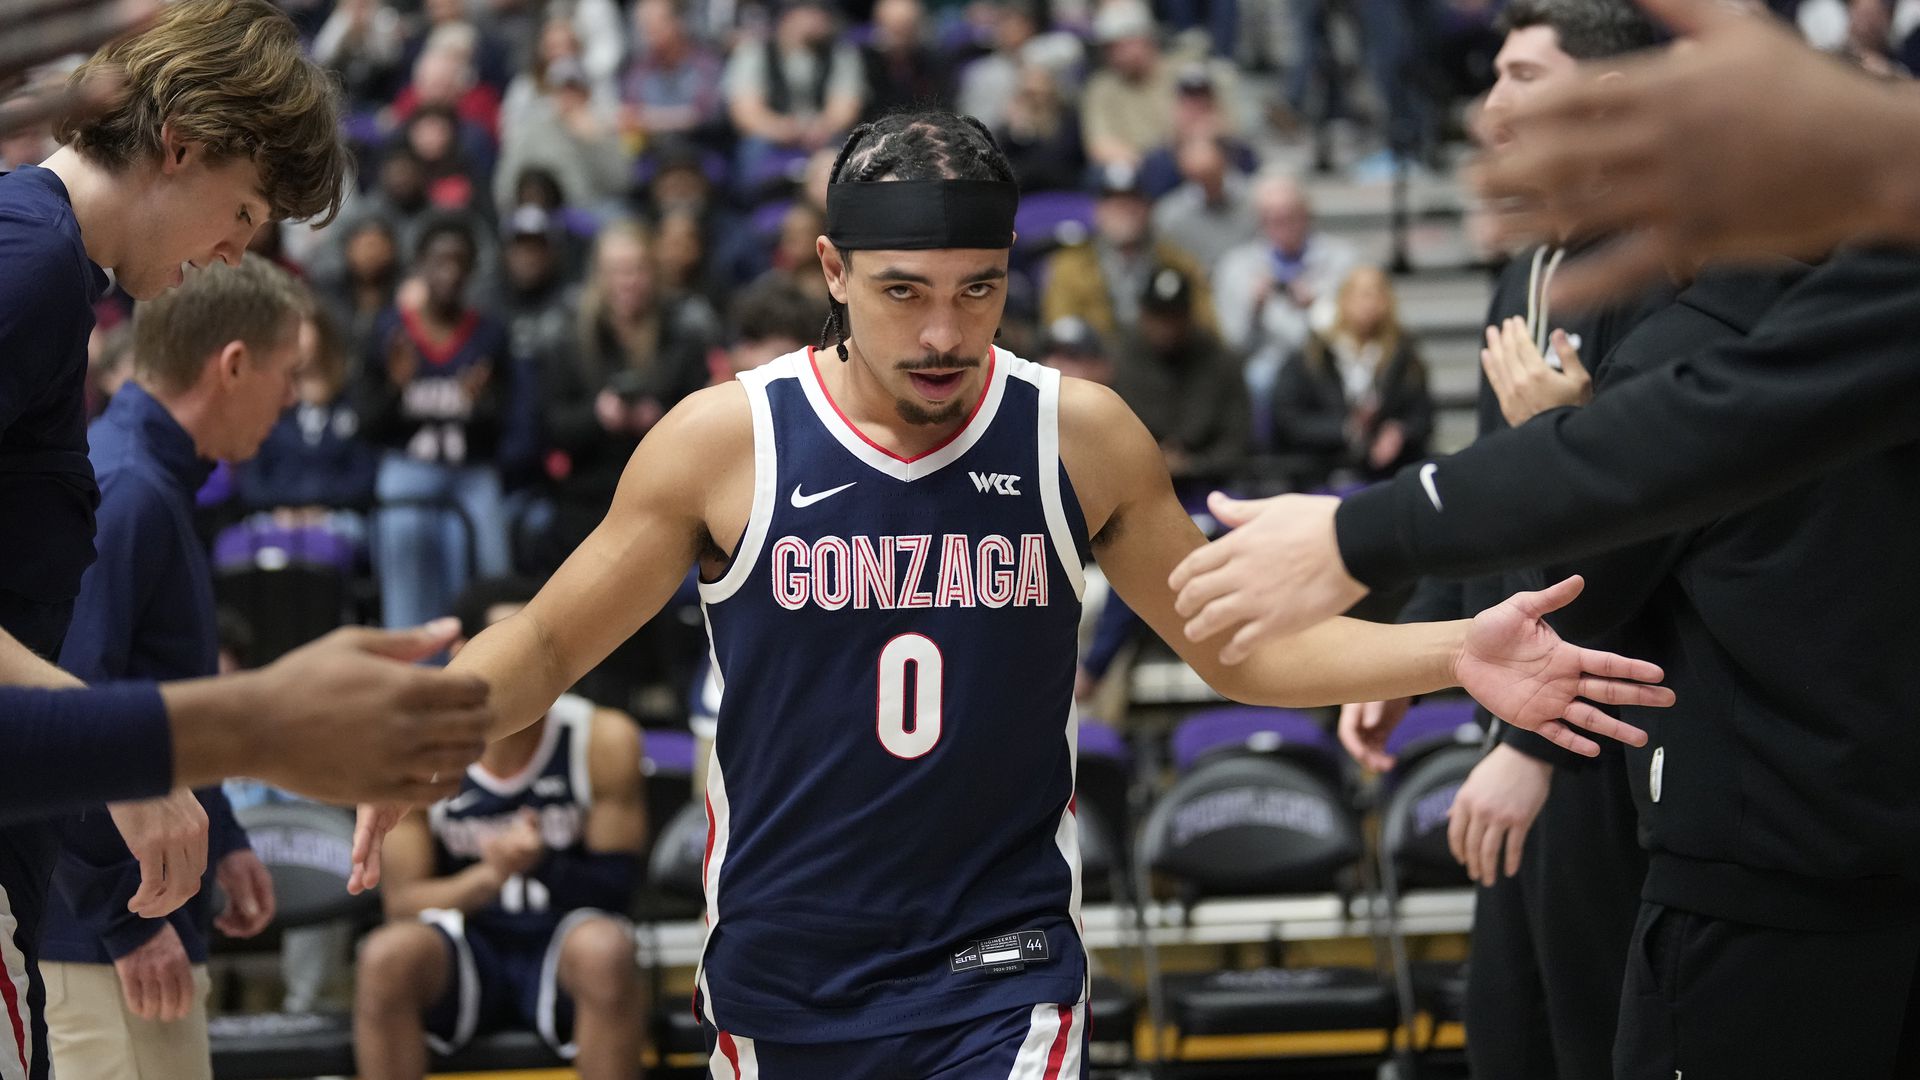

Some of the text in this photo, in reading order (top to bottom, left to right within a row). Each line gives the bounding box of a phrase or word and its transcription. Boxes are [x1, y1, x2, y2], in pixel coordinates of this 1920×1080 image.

[968, 472, 1021, 495] WCC
[772, 534, 1048, 611] GONZAGA
[876, 632, 944, 760] 0
[1026, 938, 1042, 951] 44
